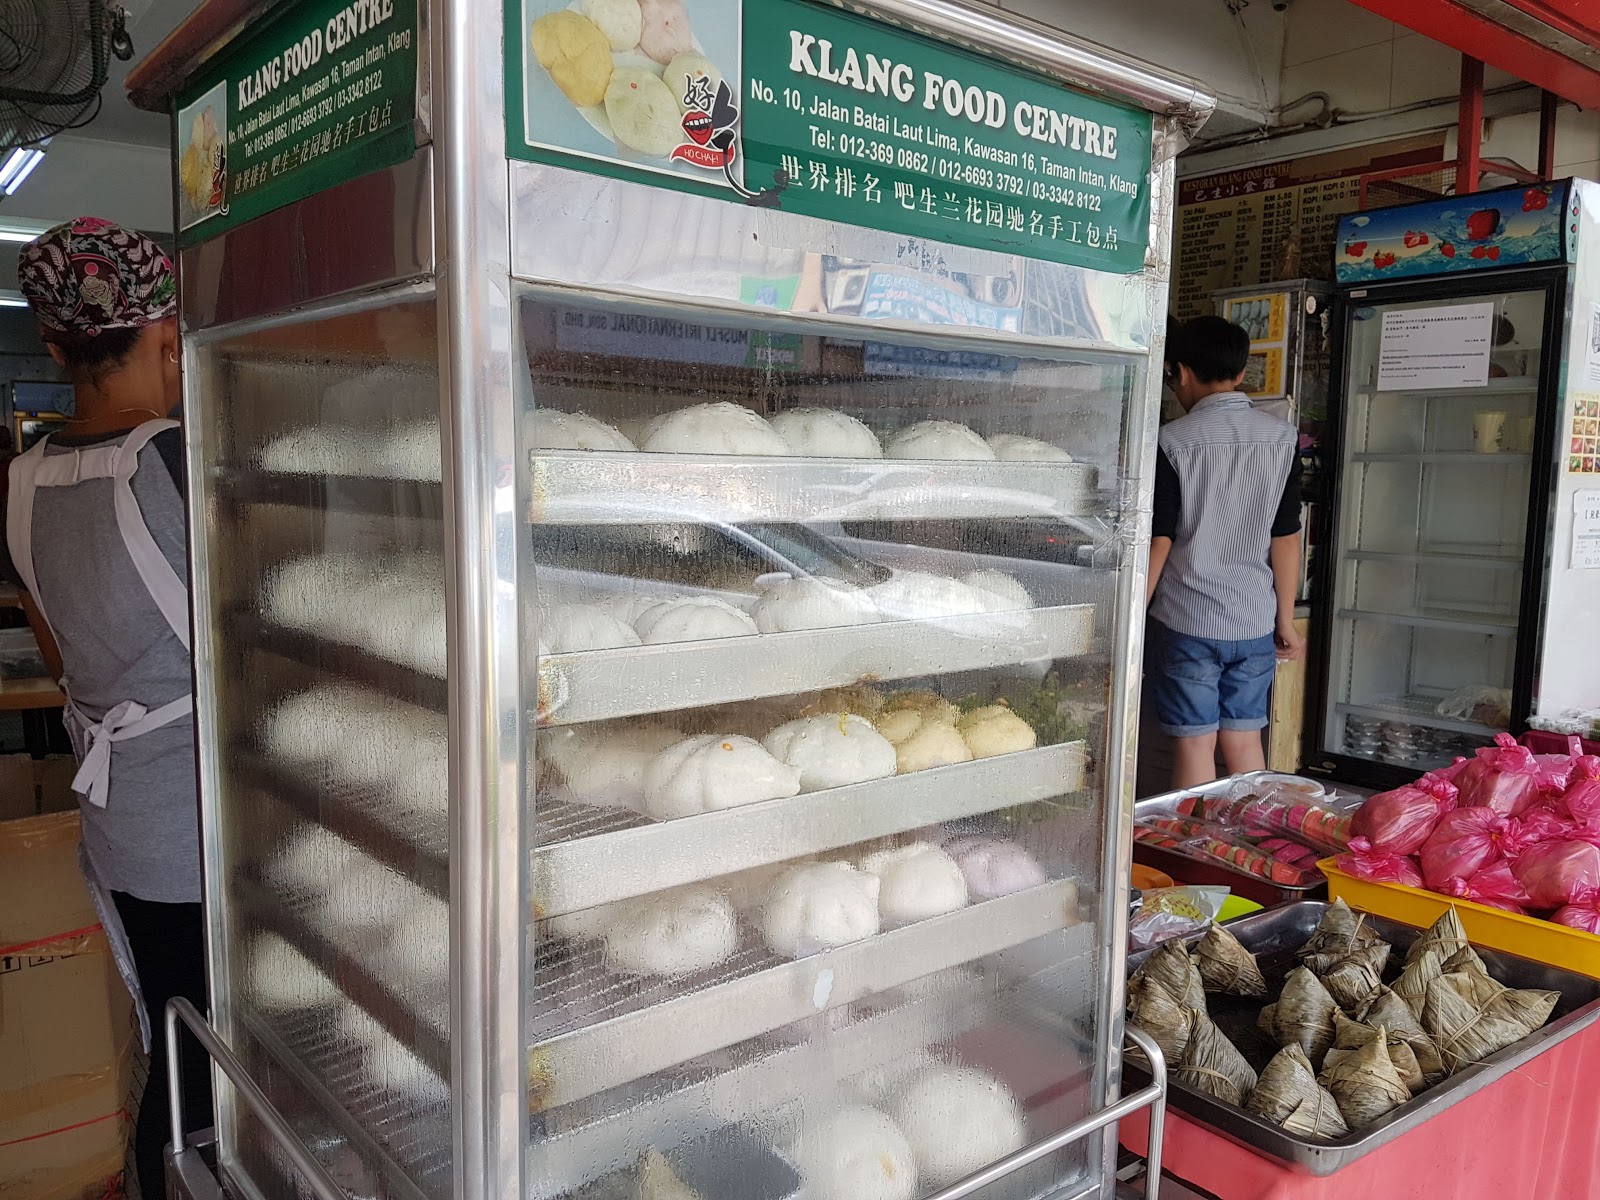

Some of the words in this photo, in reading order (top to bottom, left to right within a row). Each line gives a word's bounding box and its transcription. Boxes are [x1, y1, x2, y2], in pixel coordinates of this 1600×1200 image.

[238, 56, 281, 111] KLANG
[283, 28, 322, 83] FOOD
[326, 0, 393, 54] CENTRE
[228, 129, 236, 145] No.
[245, 116, 258, 136] Jalan
[259, 110, 271, 127] Batai
[272, 102, 285, 119] Laut
[285, 93, 301, 112] Lima,
[302, 75, 329, 103] Kawasan
[331, 66, 340, 85] 16,
[342, 55, 364, 79] Taman
[365, 43, 386, 67] Intan,
[388, 29, 411, 54] Klang
[790, 30, 915, 102] KLANG
[923, 72, 1006, 128] FOOD
[1014, 101, 1117, 160] CENTRE
[245, 141, 253, 158] Tel:
[254, 129, 273, 154] 012-369
[274, 122, 287, 142] 0862
[291, 105, 317, 134] 012-6693
[318, 96, 333, 119] 3792
[337, 79, 363, 109] 03-3342
[364, 69, 382, 94] 8122
[684, 149, 694, 158] HO
[751, 78, 778, 105] No.
[783, 87, 805, 115] 10,
[810, 95, 849, 123] Jalan
[854, 106, 889, 134] Batai
[893, 117, 923, 143] Laut
[926, 126, 960, 155] Lima,
[965, 136, 1017, 166] Kawasan
[1021, 152, 1037, 174] 16,
[1041, 156, 1076, 181] Taman
[1079, 166, 1107, 191] Intan,
[1110, 174, 1138, 200] Klang
[809, 125, 835, 150] Tel:
[840, 134, 893, 164] 012-369
[898, 149, 928, 175] 0862
[931, 155, 936, 174] /
[939, 159, 993, 188] 012-6693
[996, 173, 1023, 195] 3792
[1026, 180, 1030, 196] /
[1033, 184, 1074, 208] 03-3342
[1077, 193, 1101, 212] 8122
[1243, 167, 1262, 180] FOOD
[1304, 186, 1318, 194] KOPI
[1324, 183, 1338, 191] KOPI
[780, 154, 882, 204] 世界排名
[894, 181, 1118, 250] 吧生兰花园驰名手工包点
[1205, 210, 1232, 221] CHICKEN
[1263, 211, 1275, 219] RM
[1263, 219, 1274, 227] RM
[1303, 196, 1318, 204] KOPI
